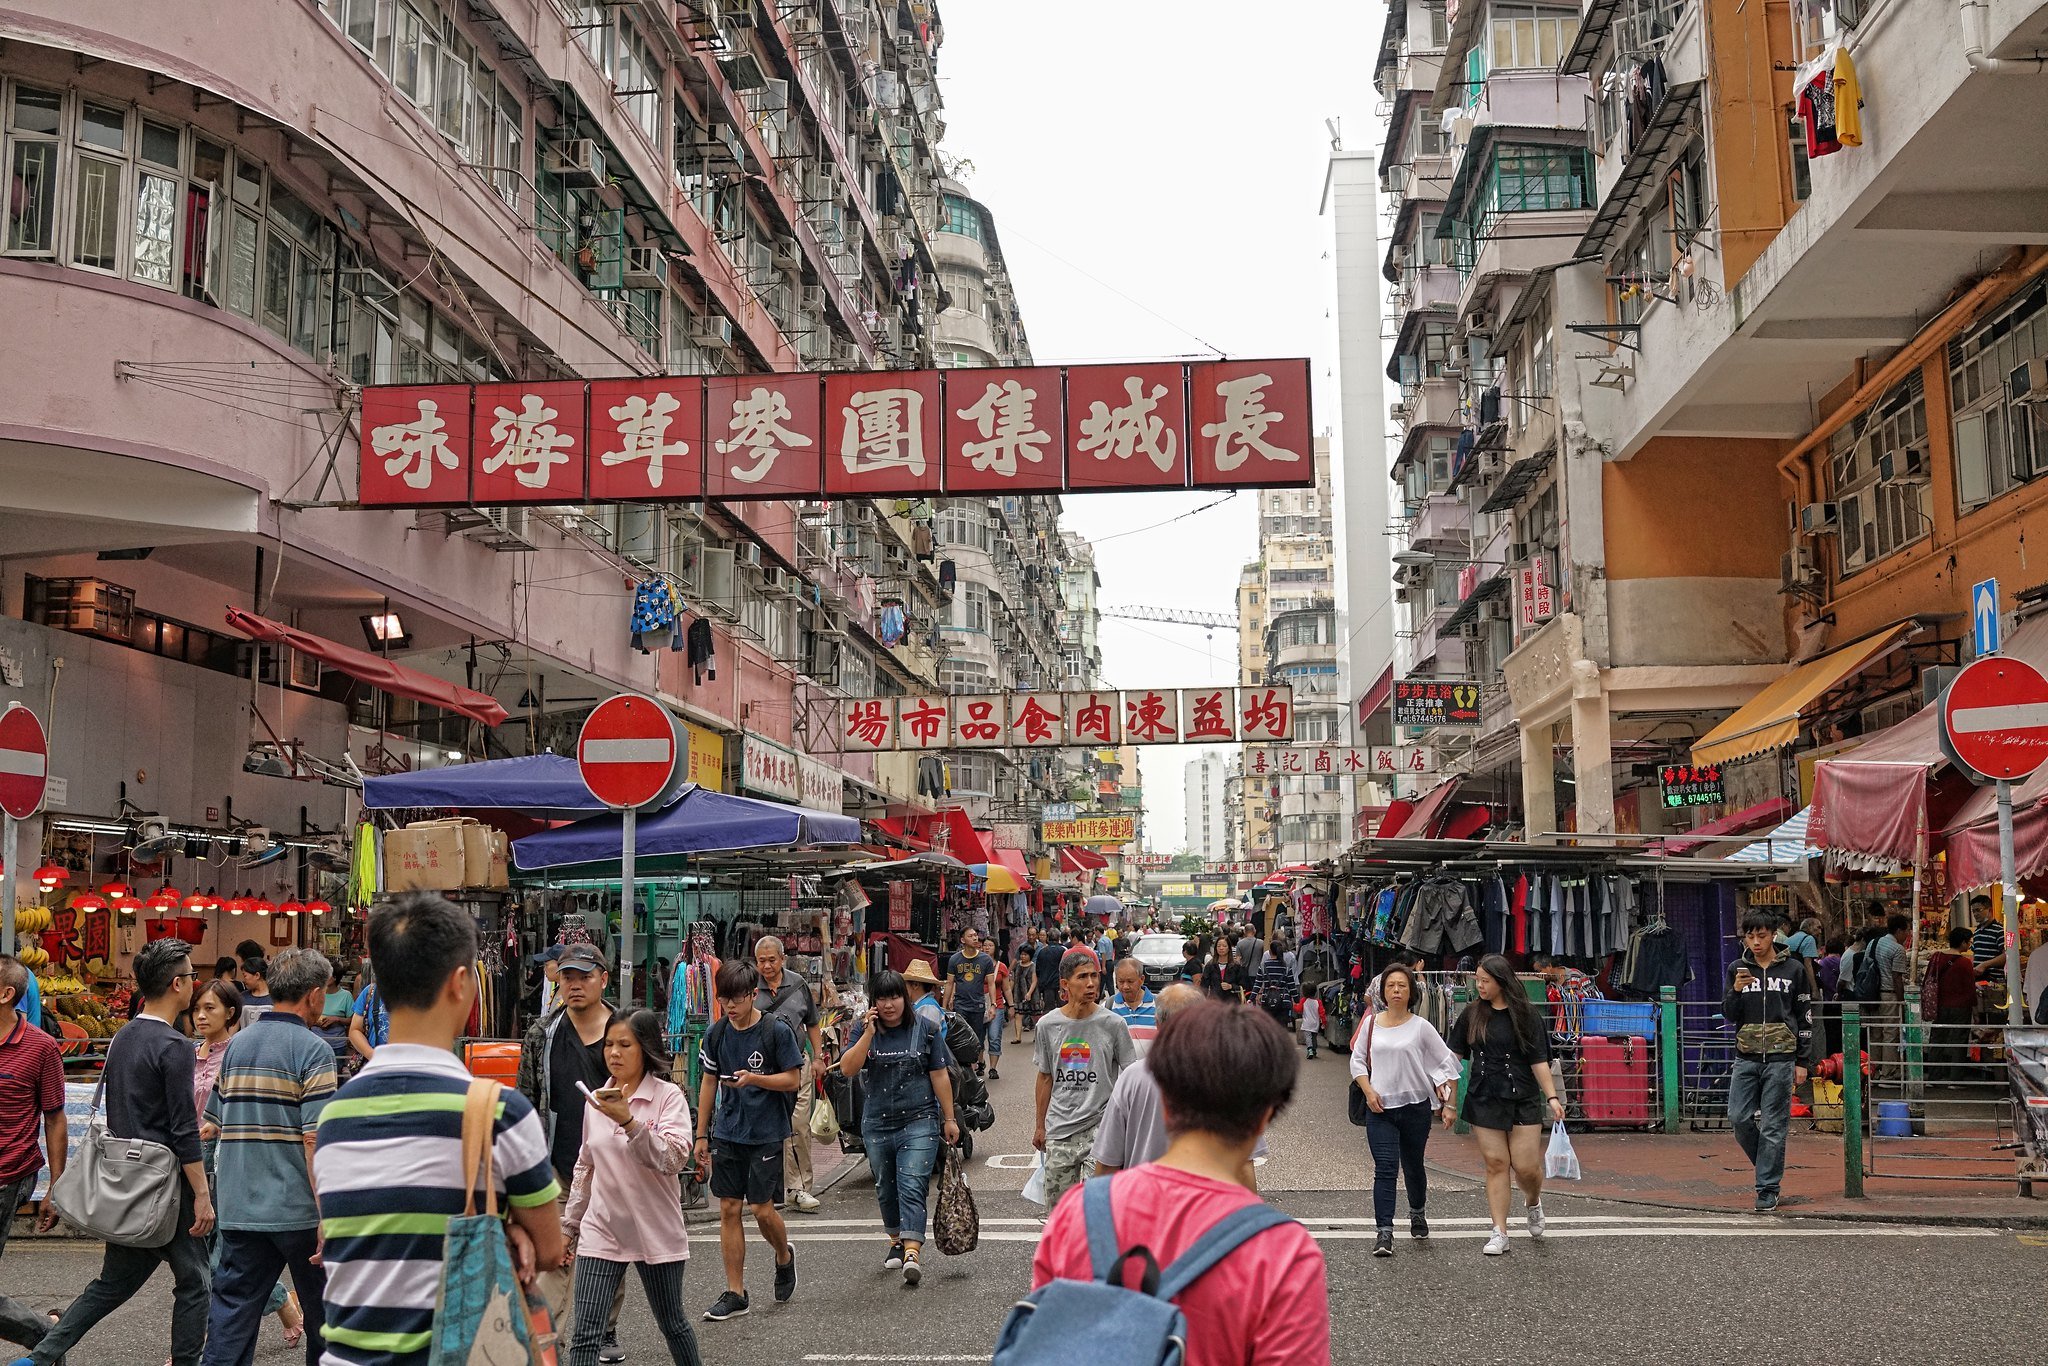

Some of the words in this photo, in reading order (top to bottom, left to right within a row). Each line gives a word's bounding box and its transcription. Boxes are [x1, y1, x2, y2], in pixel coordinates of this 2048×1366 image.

[1397, 684, 1452, 699] 步步足浴
[846, 690, 1289, 747] 均益凍肉食品市場
[1251, 748, 1425, 774] 喜記鹵水飯店
[403, 850, 438, 860] 小心放
[404, 860, 438, 869] 易碎品
